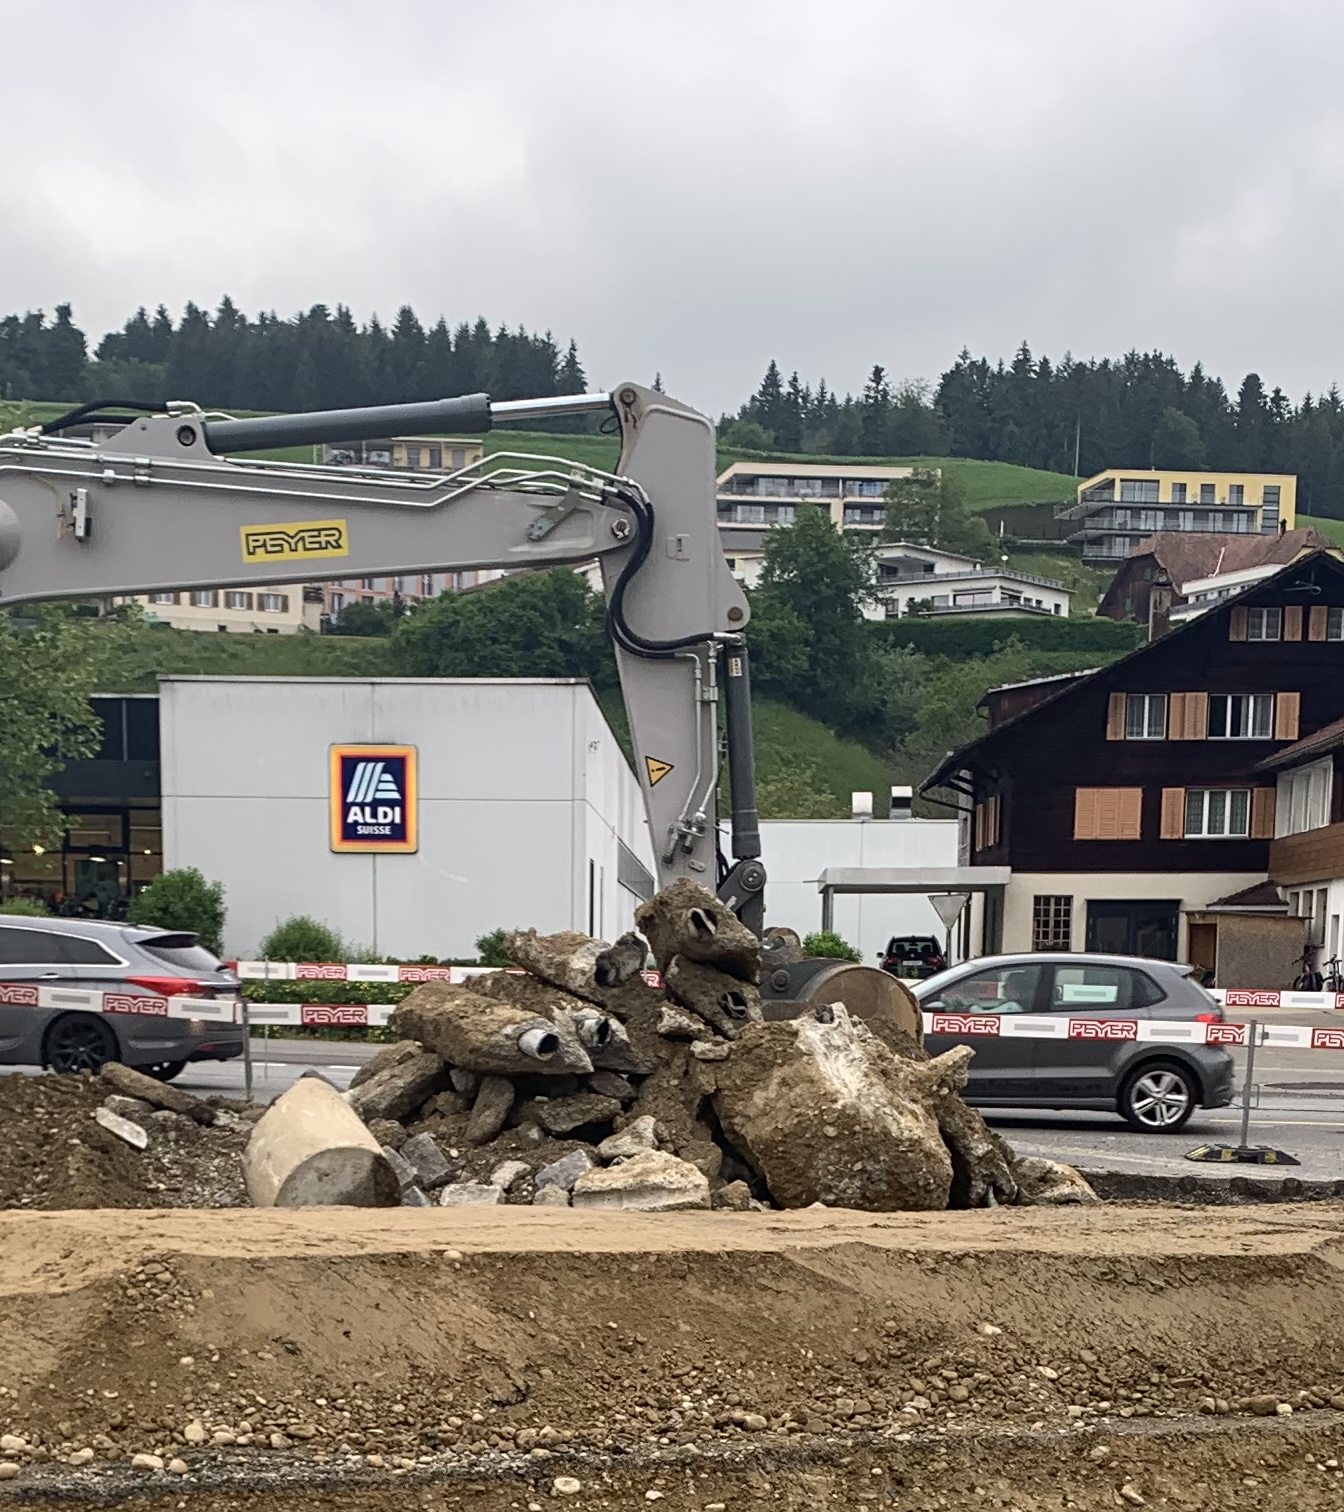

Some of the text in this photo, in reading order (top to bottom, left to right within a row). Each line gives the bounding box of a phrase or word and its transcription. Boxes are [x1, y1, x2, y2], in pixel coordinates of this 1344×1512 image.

[245, 527, 343, 555] PEYER
[346, 806, 401, 824] ALDI
[357, 826, 392, 835] SUISSE
[105, 994, 167, 1016] PEYER
[1226, 991, 1279, 1006] PEYER
[303, 1006, 367, 1023] PEYER
[933, 1015, 1000, 1034] PEYER
[1070, 1020, 1137, 1039] PEYER
